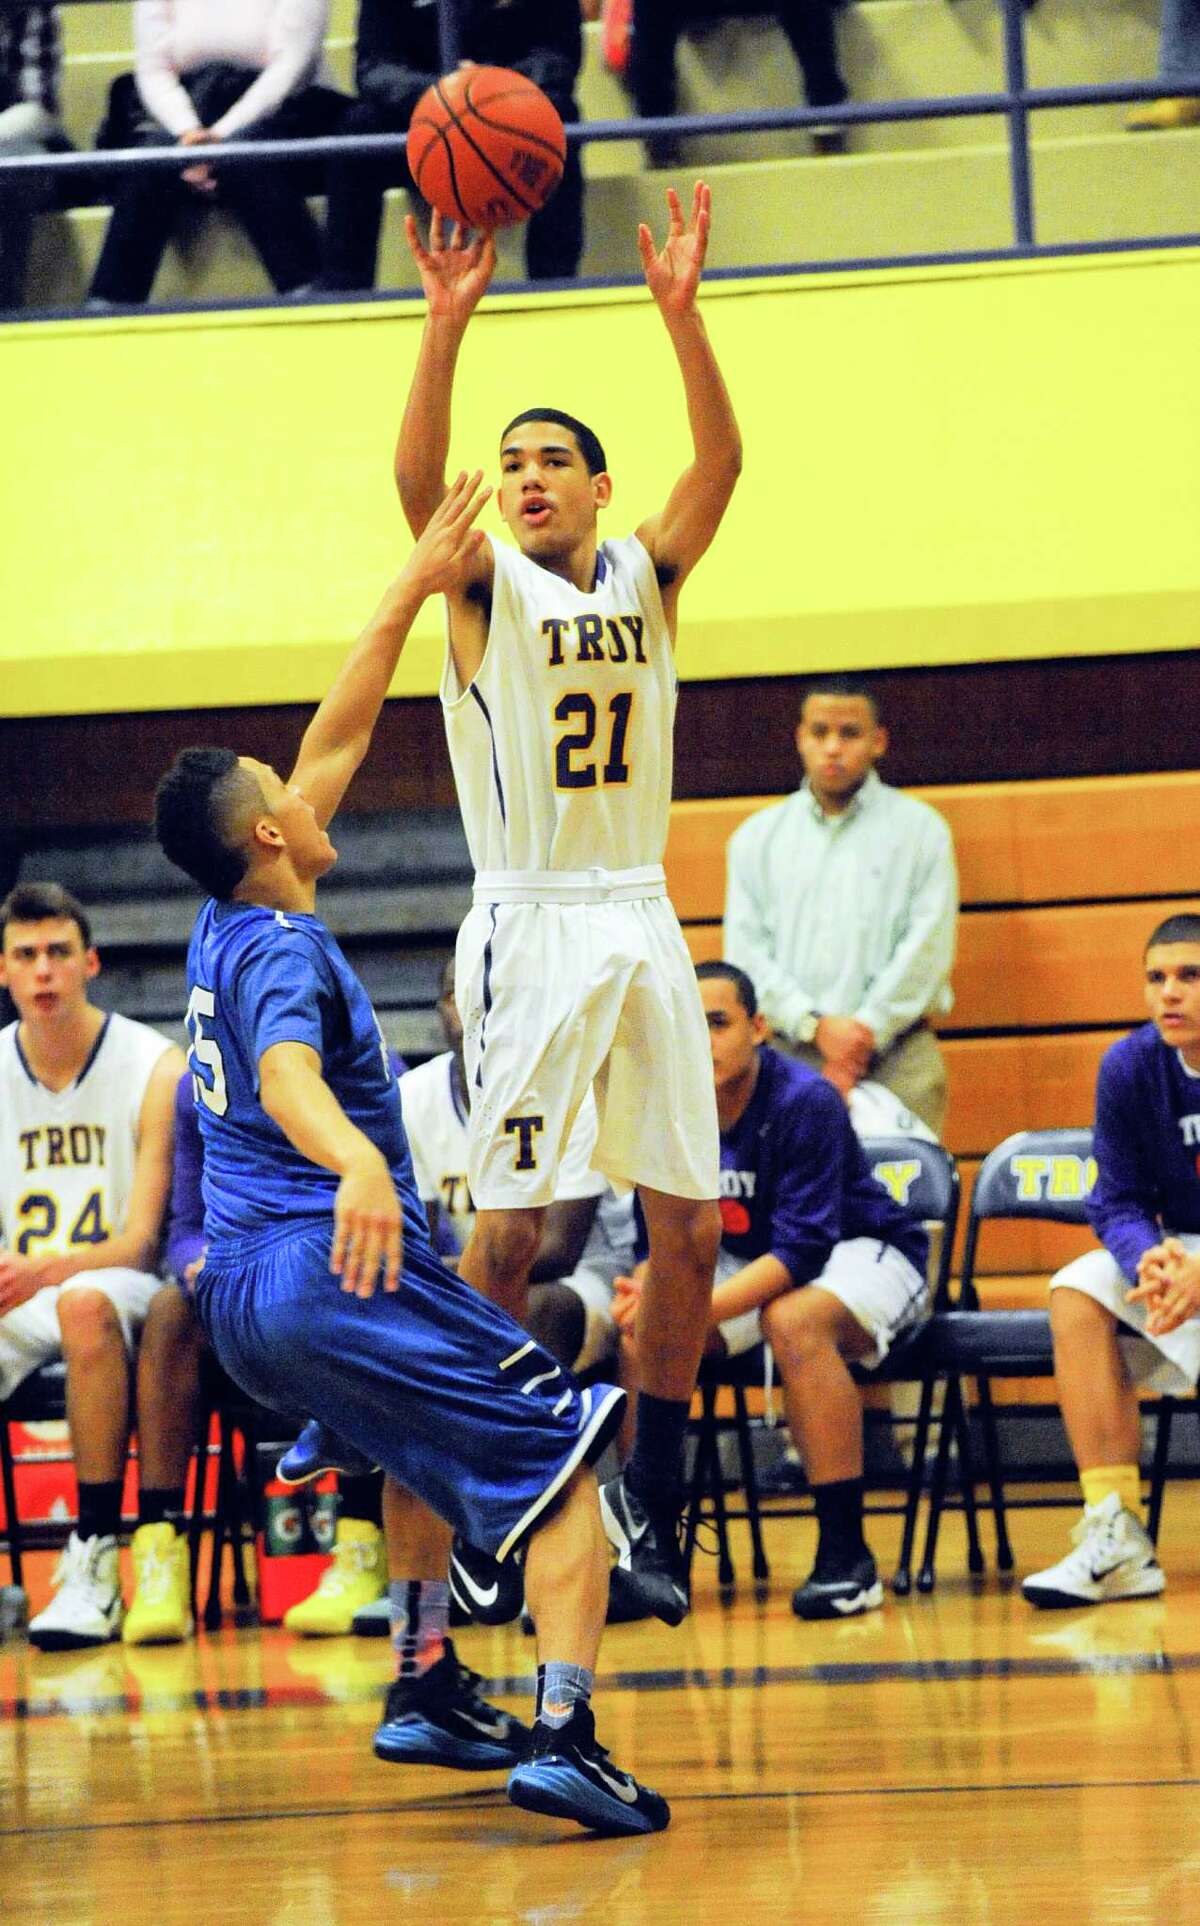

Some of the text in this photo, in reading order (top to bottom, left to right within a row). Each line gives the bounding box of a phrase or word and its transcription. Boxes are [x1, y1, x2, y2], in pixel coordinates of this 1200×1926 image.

[553, 690, 634, 789] 21
[19, 1124, 106, 1171] TROY
[504, 1115, 544, 1170] T
[17, 1190, 110, 1256] 24
[274, 1508, 302, 1543] G
